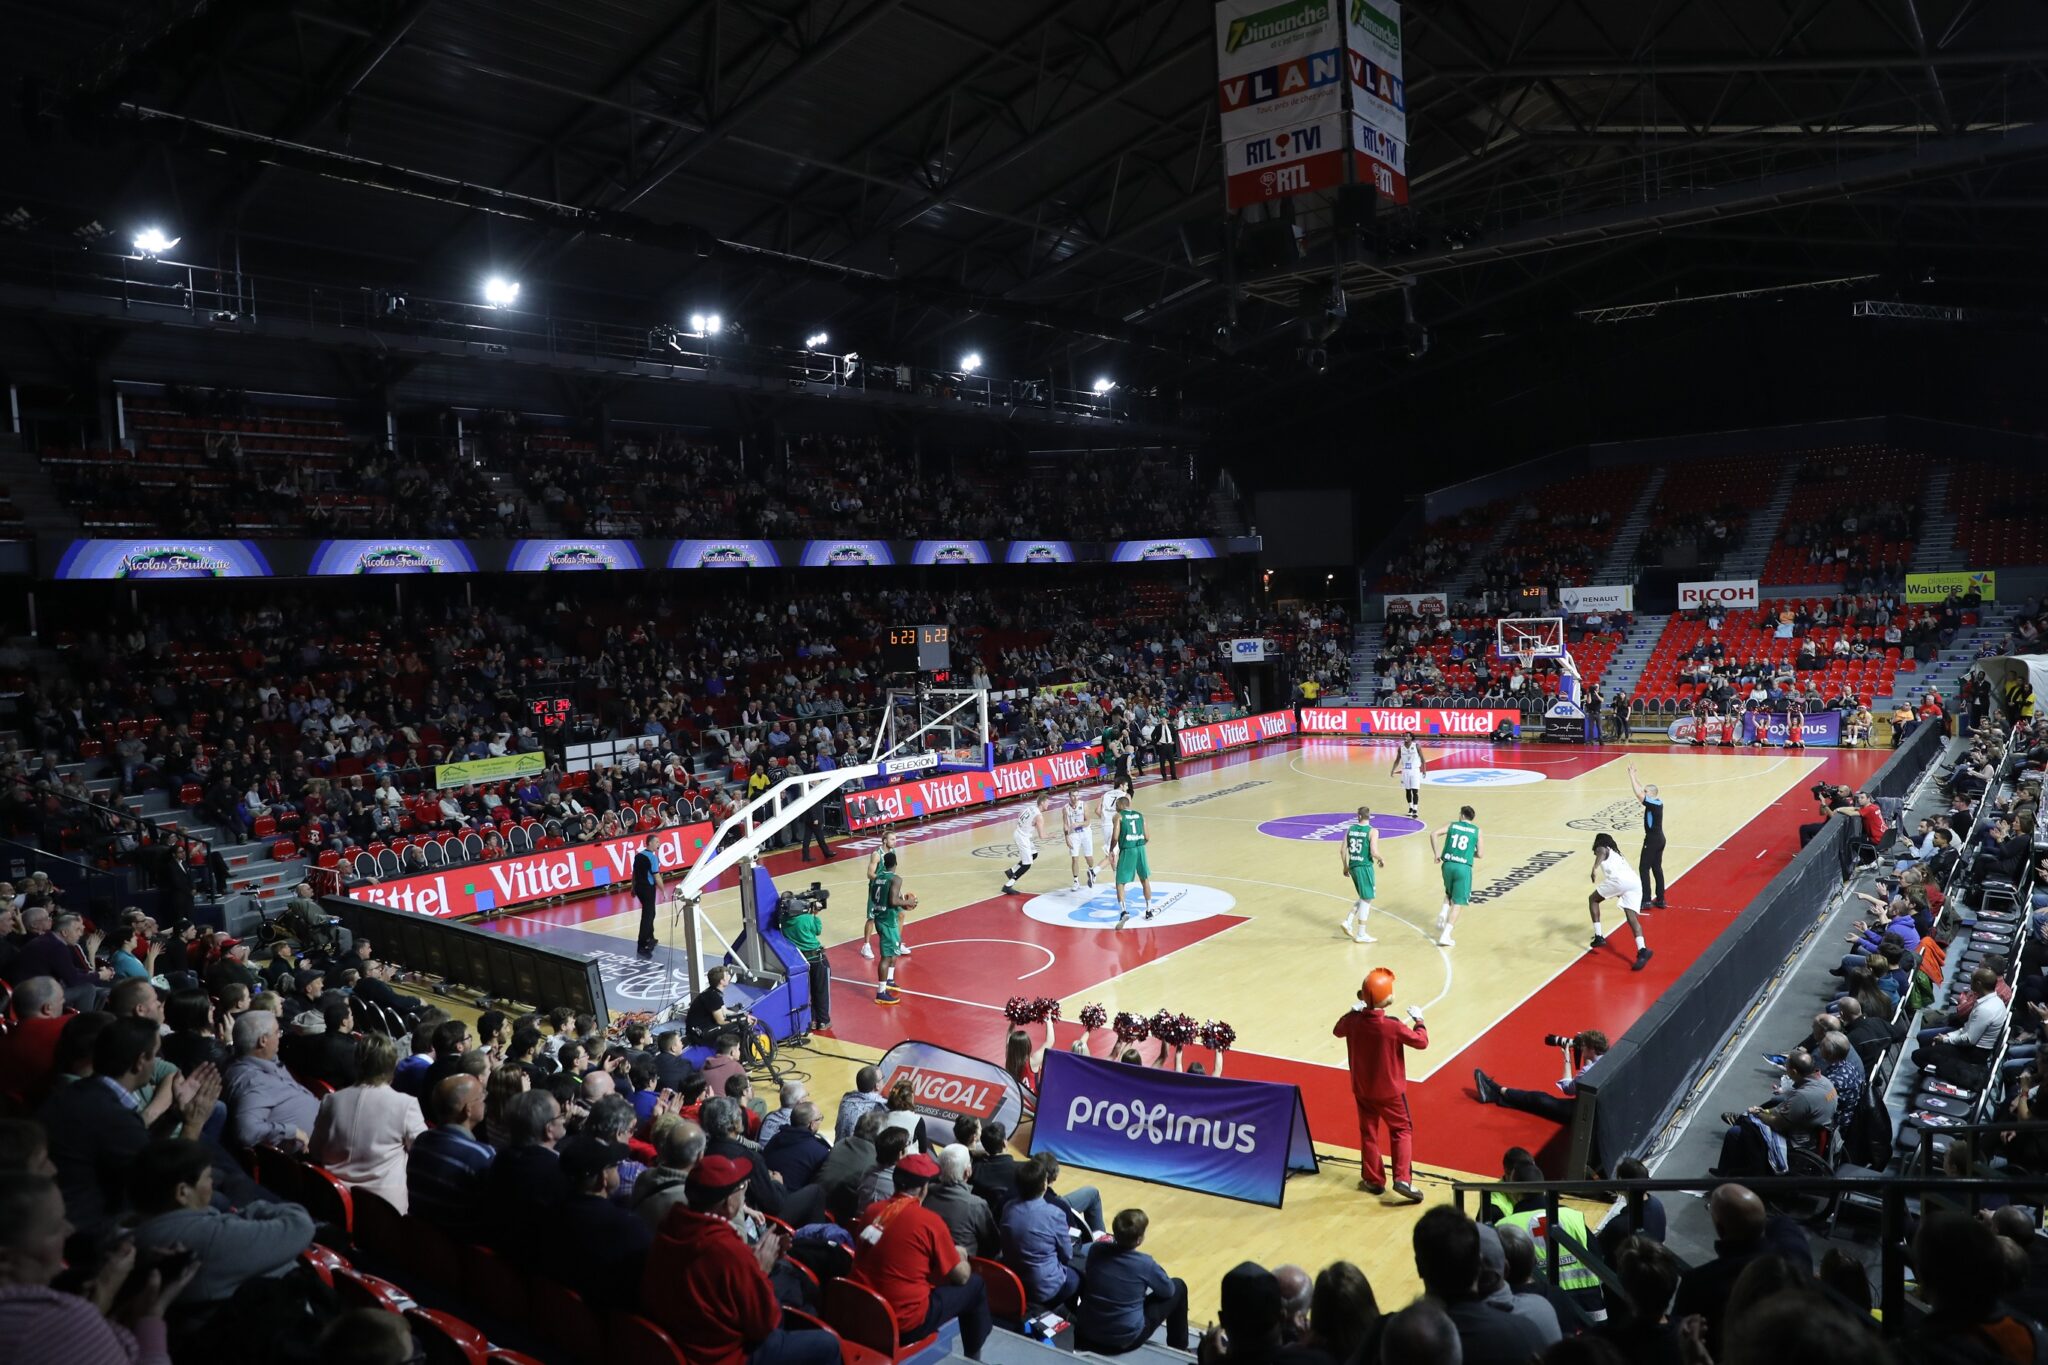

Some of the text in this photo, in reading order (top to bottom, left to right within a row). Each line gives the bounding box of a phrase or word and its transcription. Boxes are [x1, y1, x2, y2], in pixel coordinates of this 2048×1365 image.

[1223, 54, 1336, 106] VLAN
[1349, 53, 1403, 107] VLAN
[1247, 125, 1321, 166] RTL TVI
[1363, 126, 1397, 165] RTL TVI
[1276, 164, 1310, 193] RTL
[118, 554, 168, 572] Nicolas
[1582, 595, 1619, 603] RENAULT
[1683, 588, 1754, 602] RICOH
[1908, 585, 1963, 594] Wauters
[901, 630, 915, 644] 23
[935, 628, 947, 642] 23
[1179, 713, 1287, 754] Vittel Vittel Vittel
[1301, 710, 1493, 733] Vittel Vittel Vittel
[845, 788, 905, 826] itel
[918, 776, 972, 809] Vittel
[992, 763, 1037, 796] Vittel
[1048, 752, 1090, 783] Vittel
[1130, 820, 1137, 834] 1
[1349, 838, 1362, 853] 35
[1451, 833, 1469, 850] 18
[349, 832, 685, 916] ittel Vittel Viel
[1470, 850, 1575, 905] #BasketballCL
[1066, 1096, 1256, 1153] proximus
